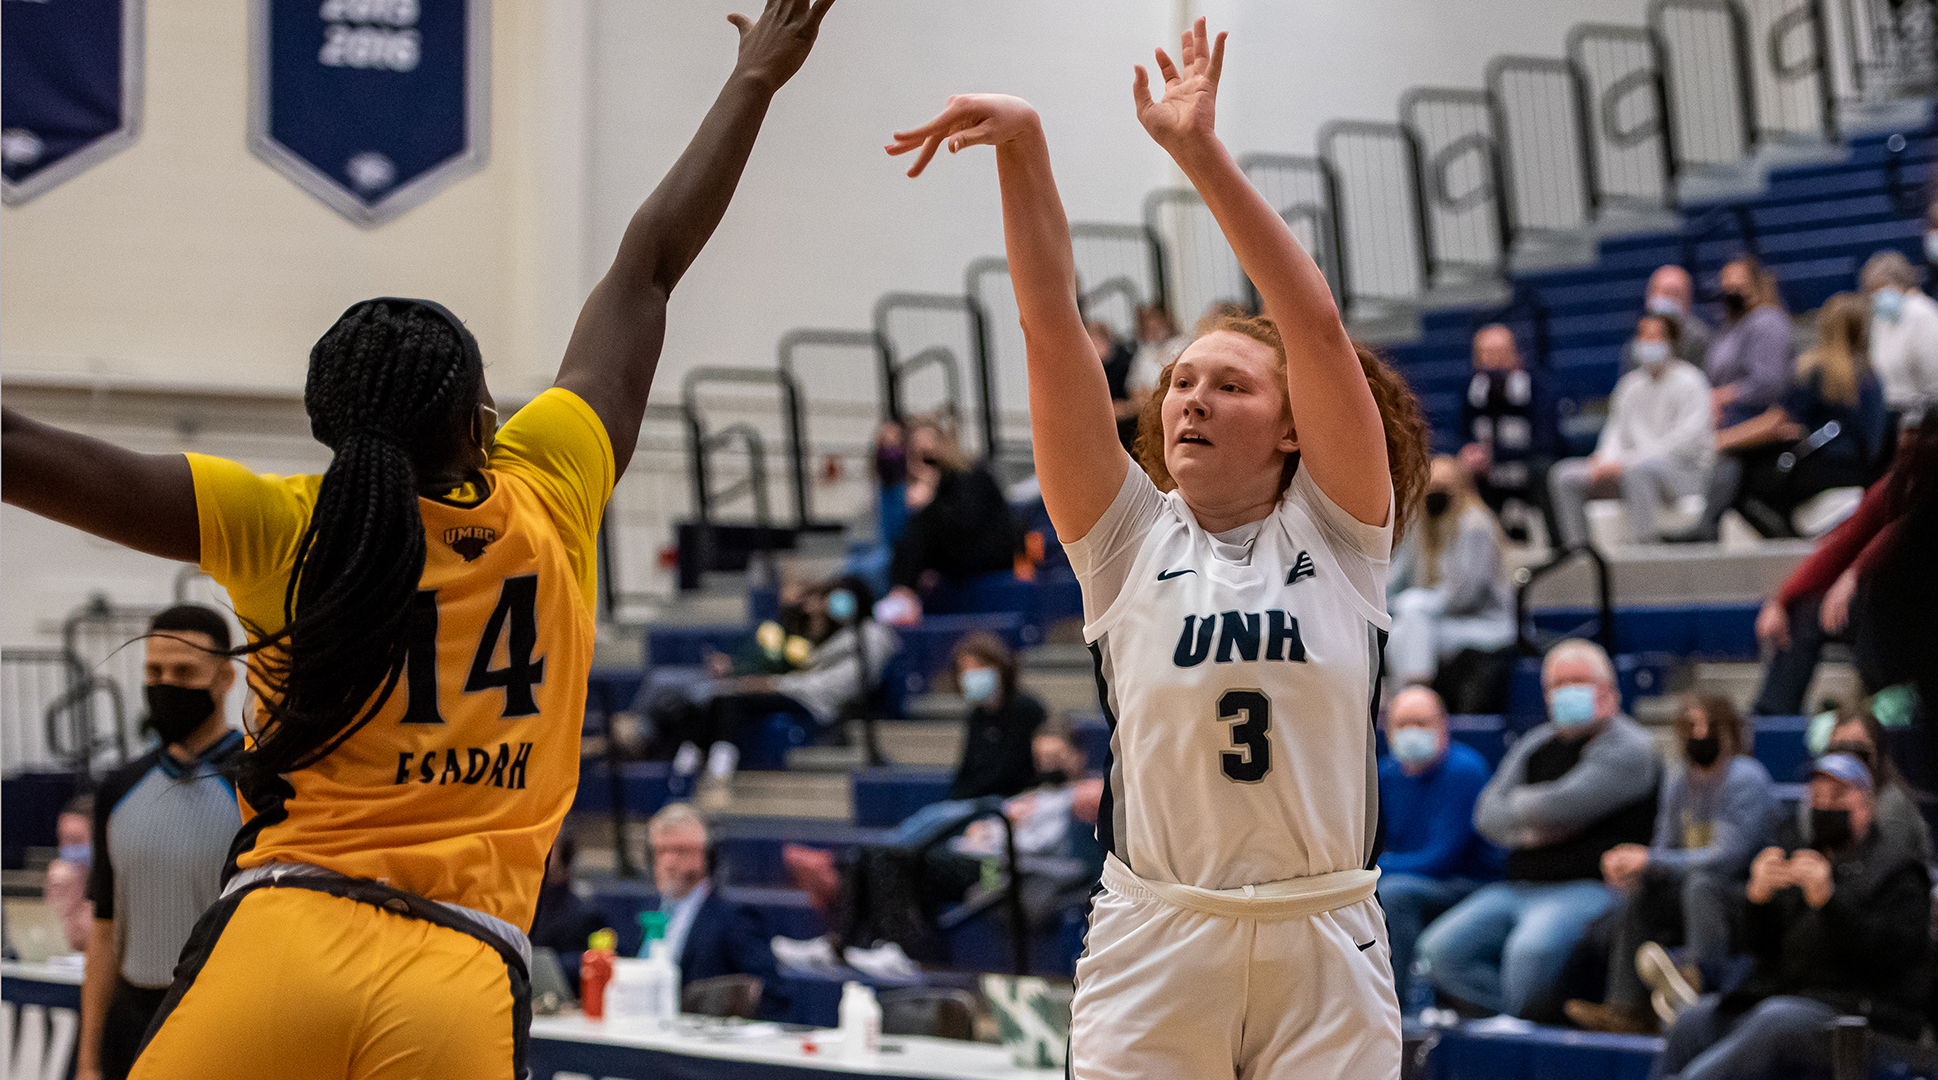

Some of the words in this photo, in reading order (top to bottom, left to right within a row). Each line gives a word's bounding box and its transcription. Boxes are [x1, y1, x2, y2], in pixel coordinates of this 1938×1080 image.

[319, 25, 421, 71] 2016
[443, 526, 496, 546] UMBC
[398, 572, 548, 724] 14
[1172, 609, 1308, 669] UNH
[1215, 687, 1273, 784] 3
